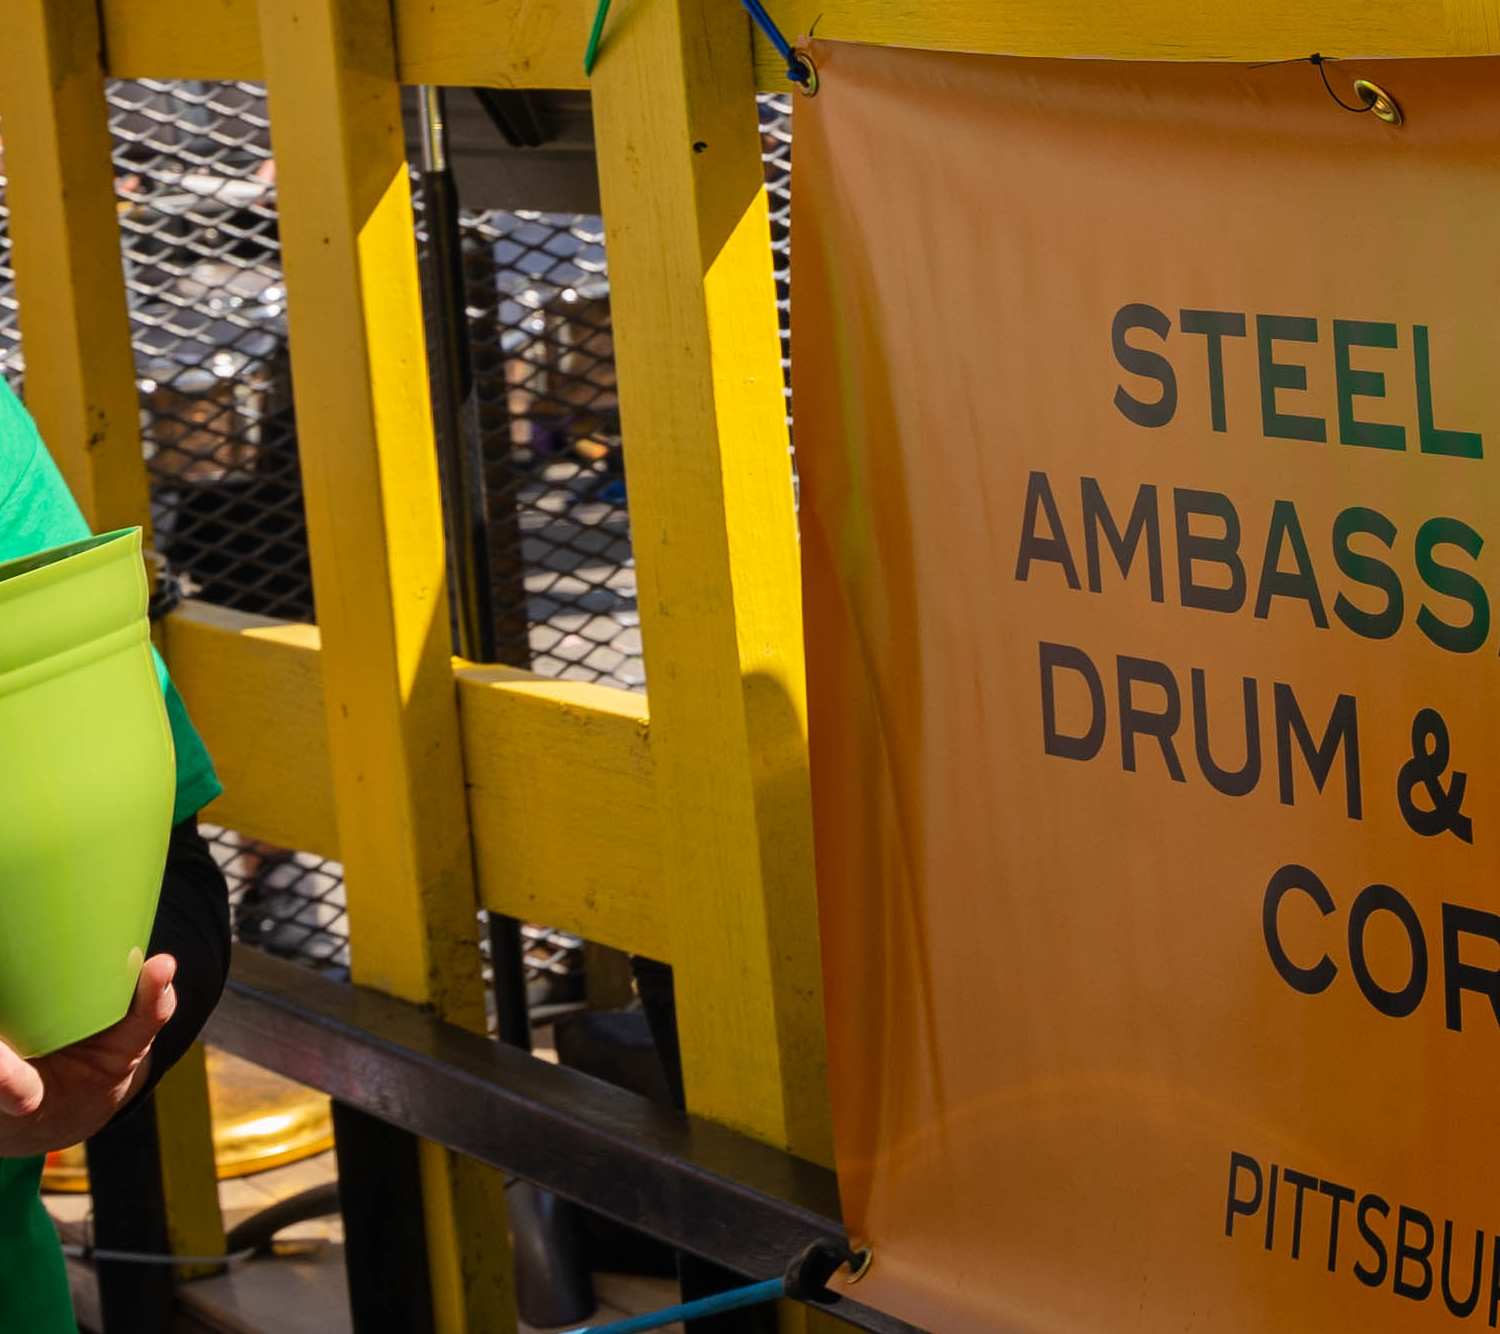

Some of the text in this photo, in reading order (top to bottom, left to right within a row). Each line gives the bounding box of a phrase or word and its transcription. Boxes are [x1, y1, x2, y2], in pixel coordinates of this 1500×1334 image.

[1112, 304, 1483, 459] STEEL
[1040, 642, 1362, 820] DRUM
[1398, 708, 1473, 844] &
